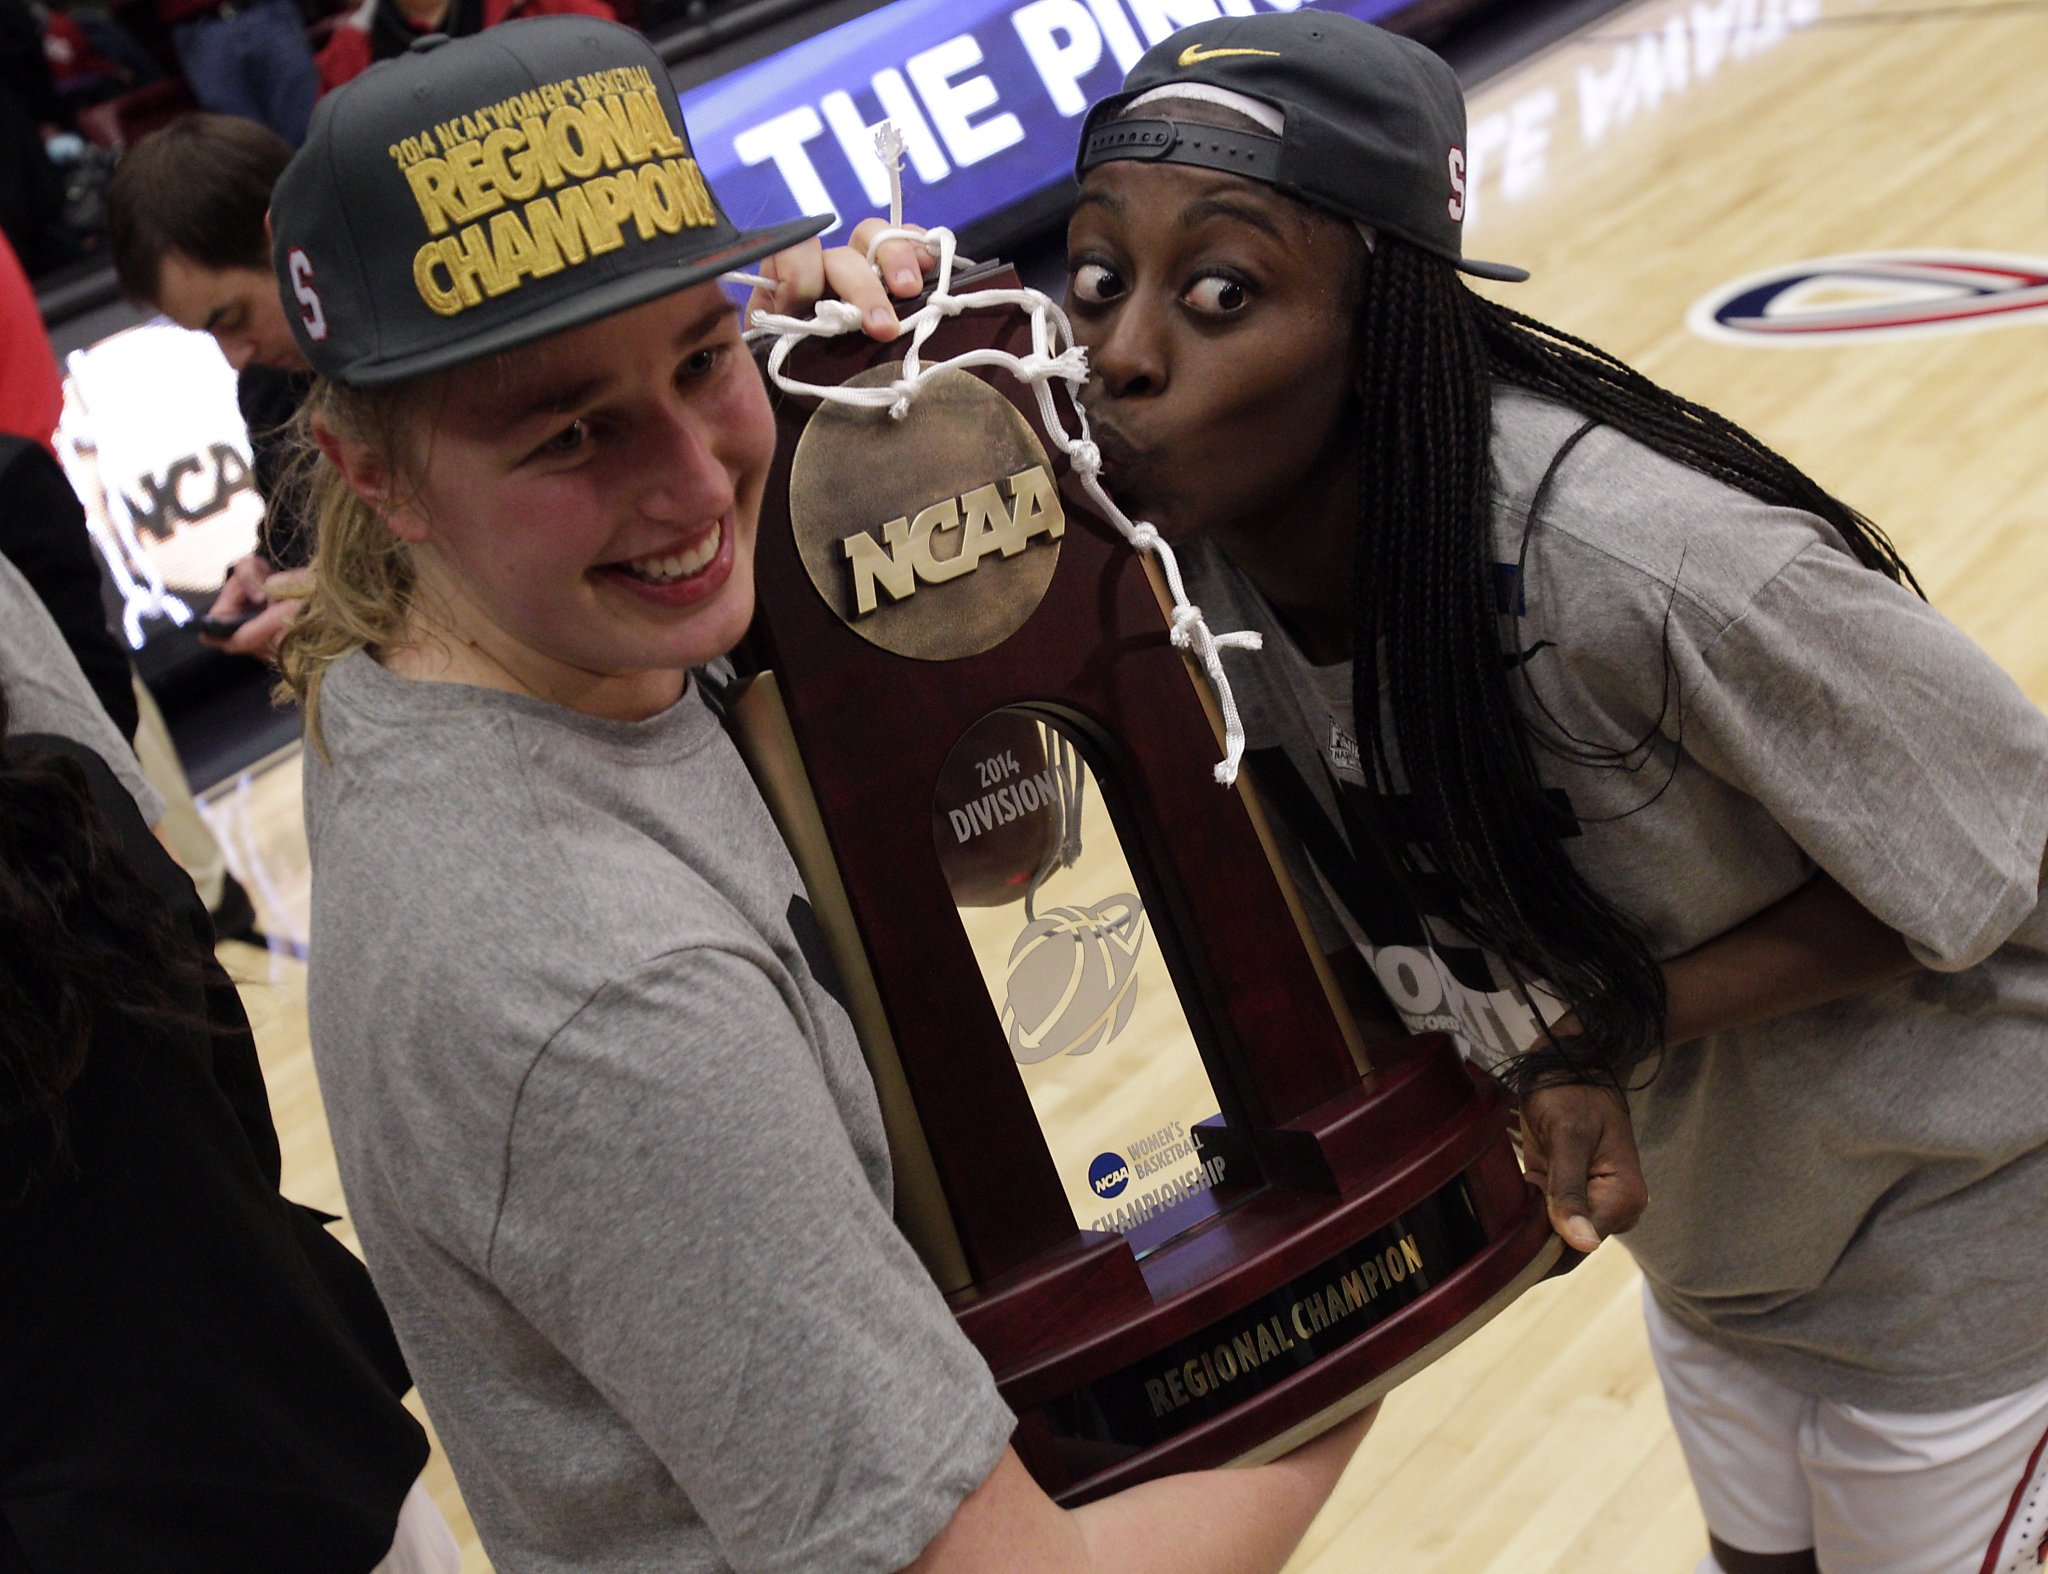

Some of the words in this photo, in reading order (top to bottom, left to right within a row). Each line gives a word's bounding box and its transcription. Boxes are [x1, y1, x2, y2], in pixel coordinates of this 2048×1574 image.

[388, 130, 438, 170] 2014
[434, 108, 494, 150] NCAA
[491, 79, 583, 128] WOMEN'S
[405, 88, 685, 236] REGIONAL
[732, 33, 1025, 237] THE
[287, 246, 329, 342] S
[843, 464, 1066, 618] NCAA
[947, 768, 1060, 844] DIVISION
[974, 749, 1021, 790] 2014
[1094, 1165, 1130, 1194] NCAA
[1126, 1120, 1185, 1162] WOMEN'S
[1134, 1132, 1205, 1180] BASKETBALL
[1144, 1314, 1295, 1418] REGIONAL
[1290, 1232, 1425, 1341] CHAMPION
